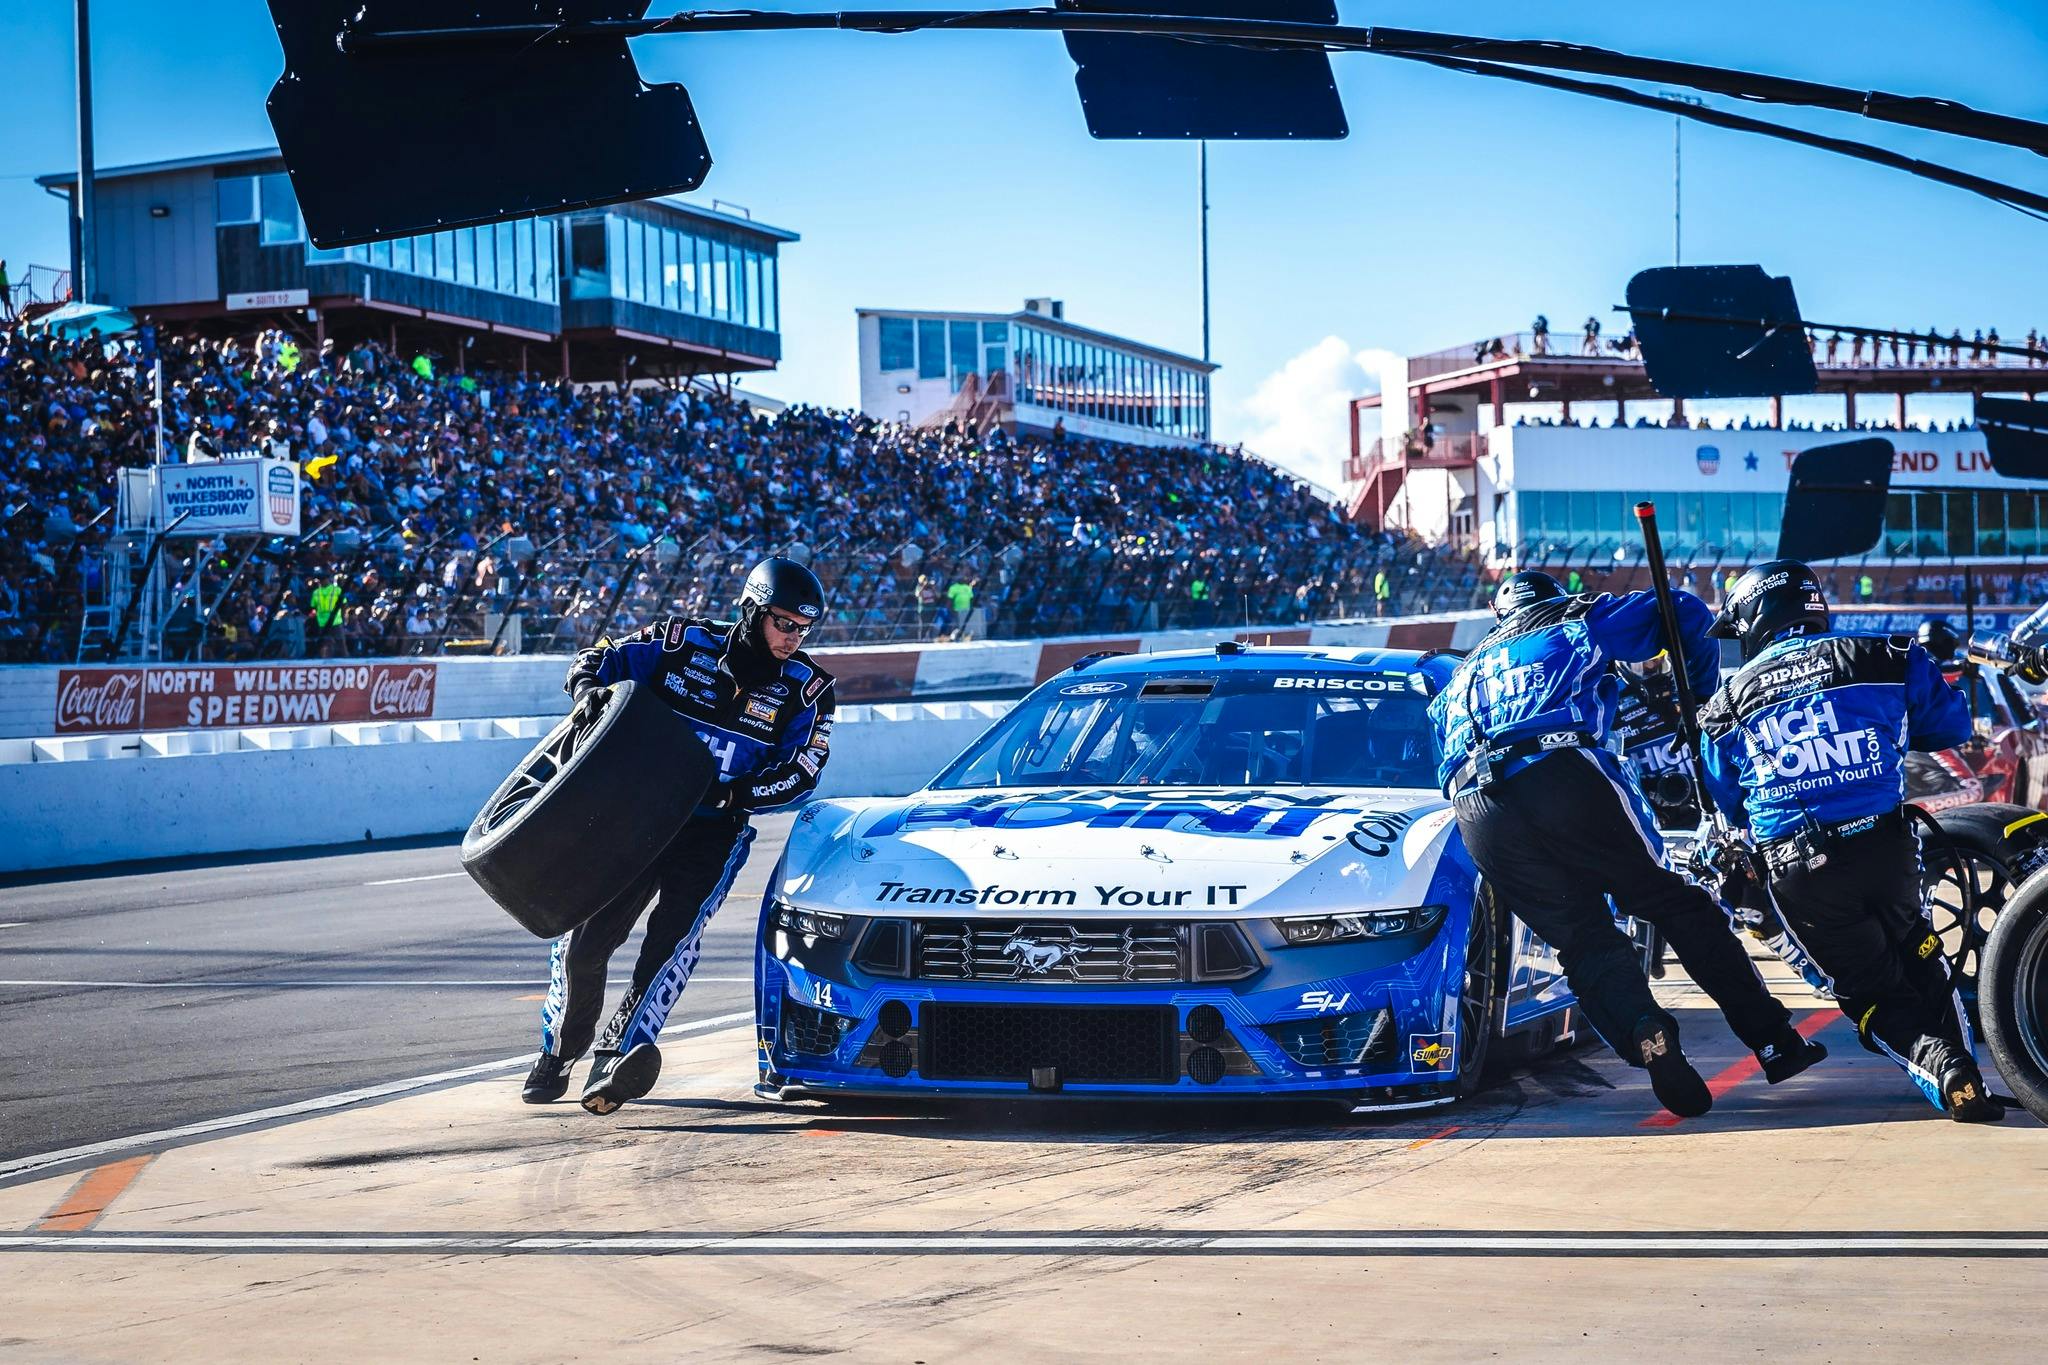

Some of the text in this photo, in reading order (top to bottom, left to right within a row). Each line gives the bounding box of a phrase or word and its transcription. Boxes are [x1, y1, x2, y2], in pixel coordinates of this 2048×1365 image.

[186, 475, 233, 490] NORTH
[167, 488, 255, 505] WILKESBORO
[173, 502, 249, 518] SPEEDWAY
[1743, 579, 1787, 605] TRACTORS
[1809, 592, 1820, 602] 14
[801, 605, 818, 616] Ford
[147, 666, 370, 695] NORTH WILKESBORO
[666, 671, 685, 687] HIGH
[1273, 677, 1406, 692] BRISCOE
[1758, 656, 1831, 688] PIPALA
[1764, 672, 1833, 697] STEWART
[57, 673, 141, 727] Coca-Cola
[370, 668, 435, 715] Coca-Cola
[664, 678, 686, 697] POINT
[1067, 683, 1118, 695] Ford
[187, 693, 336, 726] SPEEDWAY
[739, 716, 773, 732] GOODYEAR
[1746, 700, 1839, 756] HIGH
[1865, 727, 1880, 762] .COM
[1751, 730, 1867, 786] POINT
[1757, 761, 1883, 801] Transform Your IT
[875, 881, 1248, 907] Transform Your IT
[813, 981, 833, 1008] 14
[1295, 990, 1351, 1012] SH
